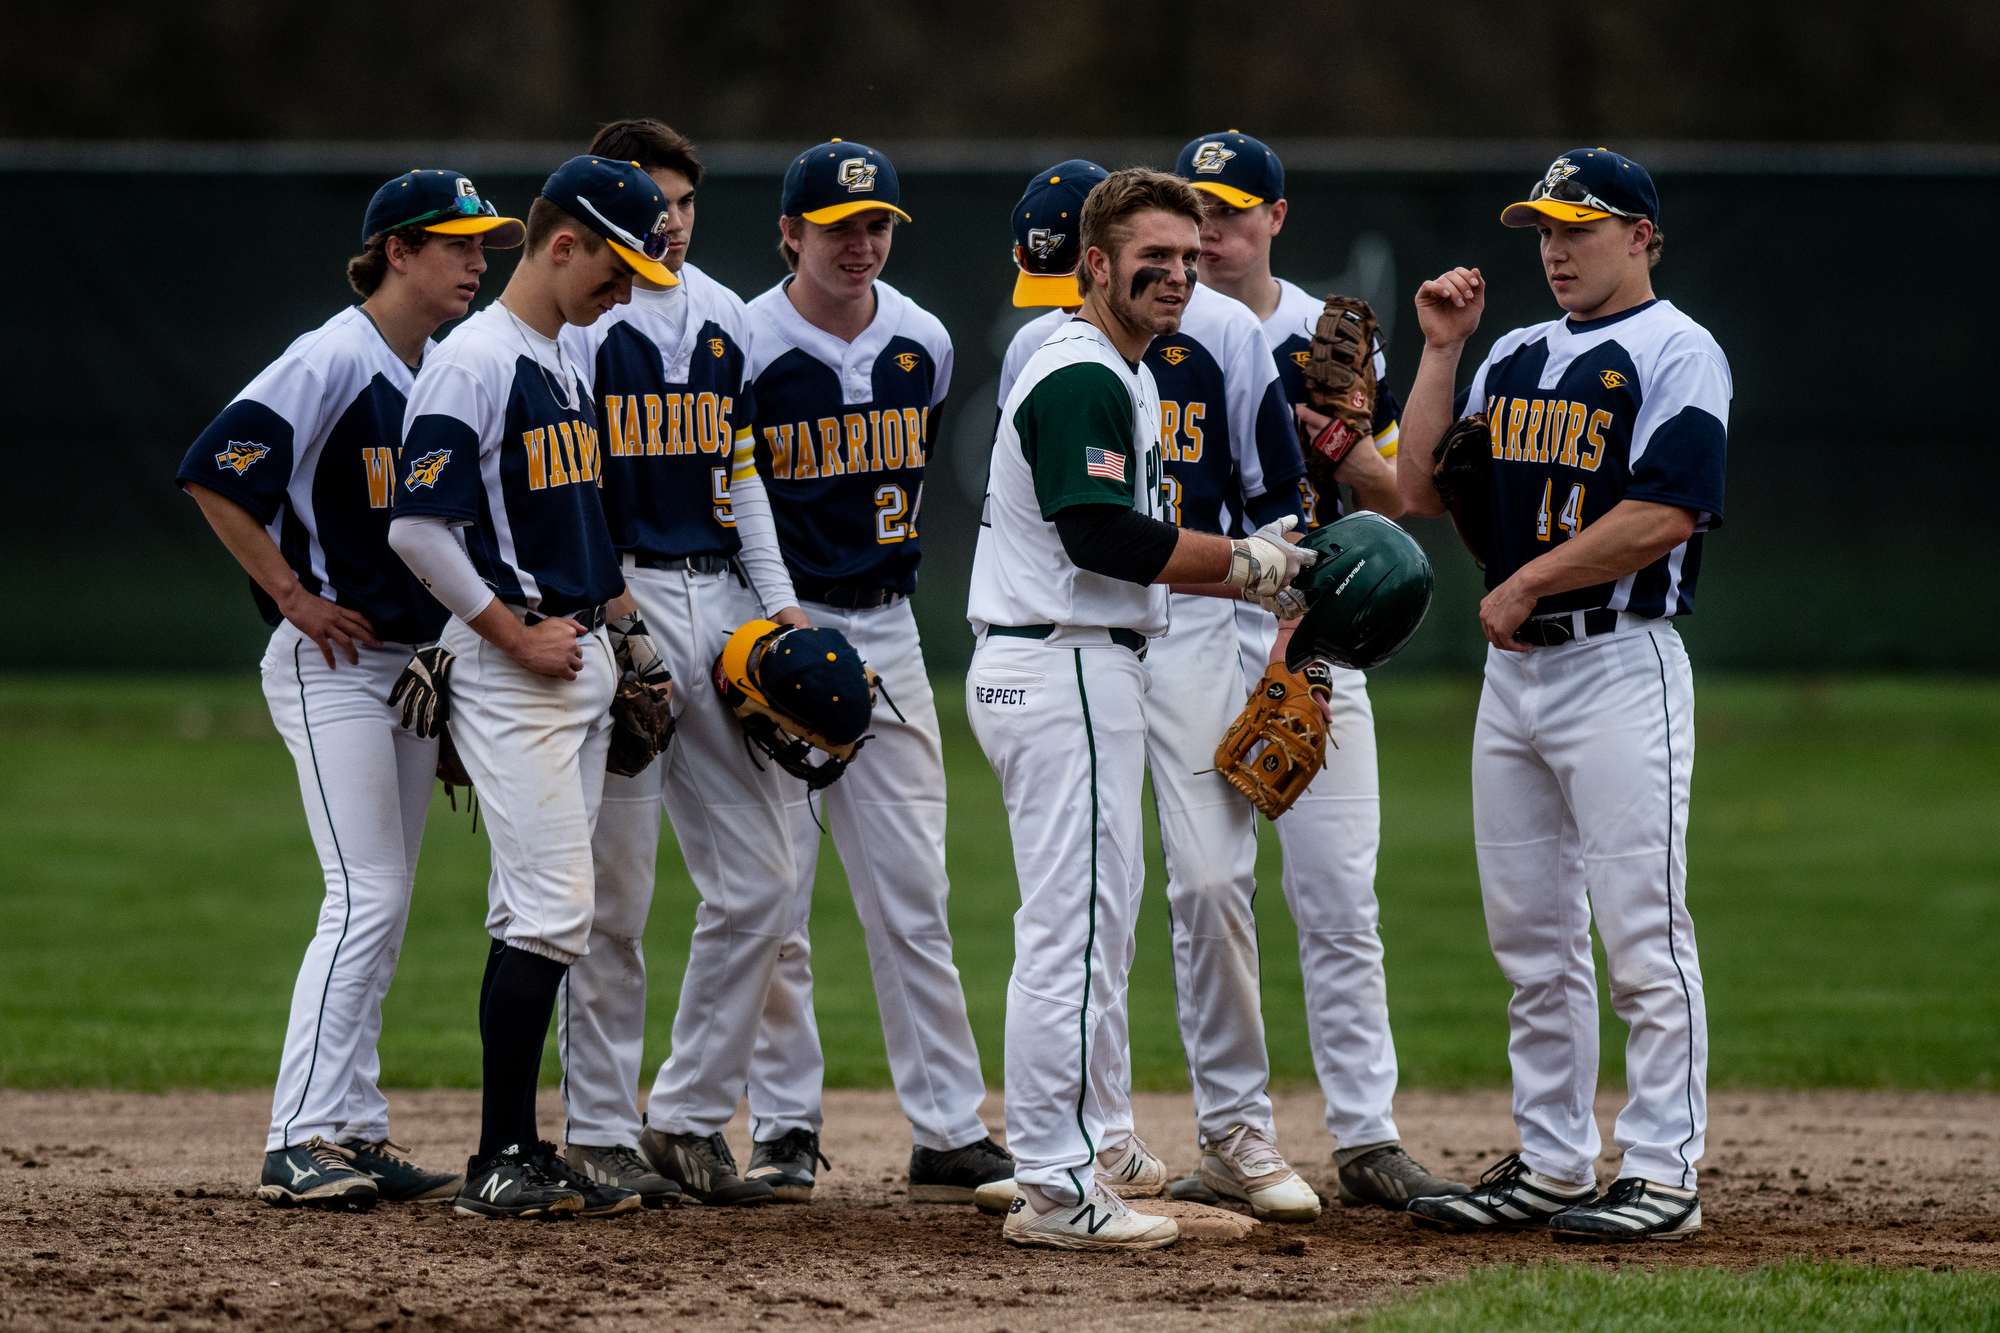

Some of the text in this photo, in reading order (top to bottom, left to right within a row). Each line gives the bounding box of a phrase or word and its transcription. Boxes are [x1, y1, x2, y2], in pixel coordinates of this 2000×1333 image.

[1487, 395, 1613, 472] ARRIORS
[1537, 478, 1586, 541] 44
[1335, 559, 1366, 596] RAWLINGS
